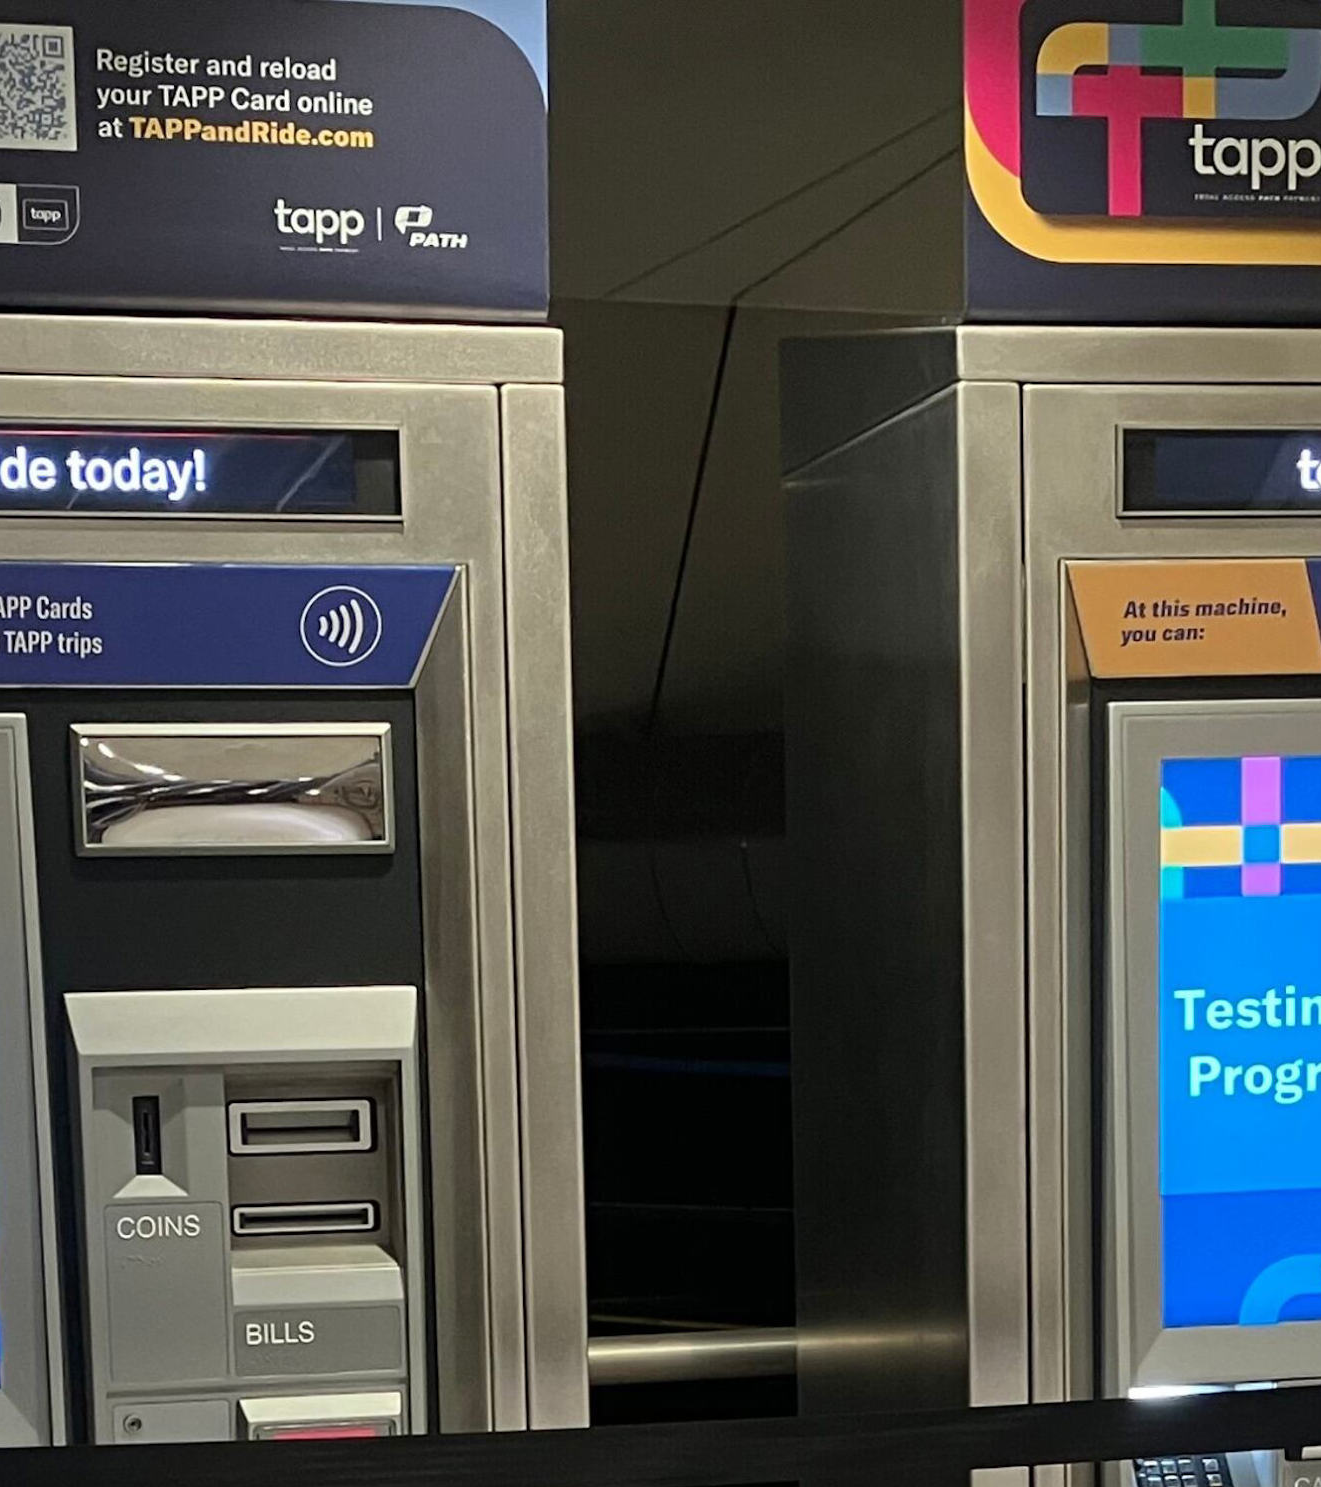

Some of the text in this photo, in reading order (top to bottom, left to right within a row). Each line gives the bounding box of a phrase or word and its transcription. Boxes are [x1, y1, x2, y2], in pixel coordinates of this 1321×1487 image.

[97, 49, 336, 80] Register and reload
[97, 85, 372, 115] your TAPP Card online
[99, 117, 373, 147] at TAPPandRide.com
[1189, 124, 1321, 190] tapp
[31, 208, 61, 222] tapp
[274, 199, 364, 244] tapp
[410, 233, 467, 248] PATH
[66, 448, 207, 502] today!
[37, 596, 92, 619] Cards
[1124, 598, 1286, 618] At this machine,
[4, 631, 52, 653] TAPP
[58, 632, 102, 658] trips
[1121, 628, 1204, 646] you can:
[118, 1215, 200, 1239] COINS
[247, 1321, 314, 1344] BILLS
